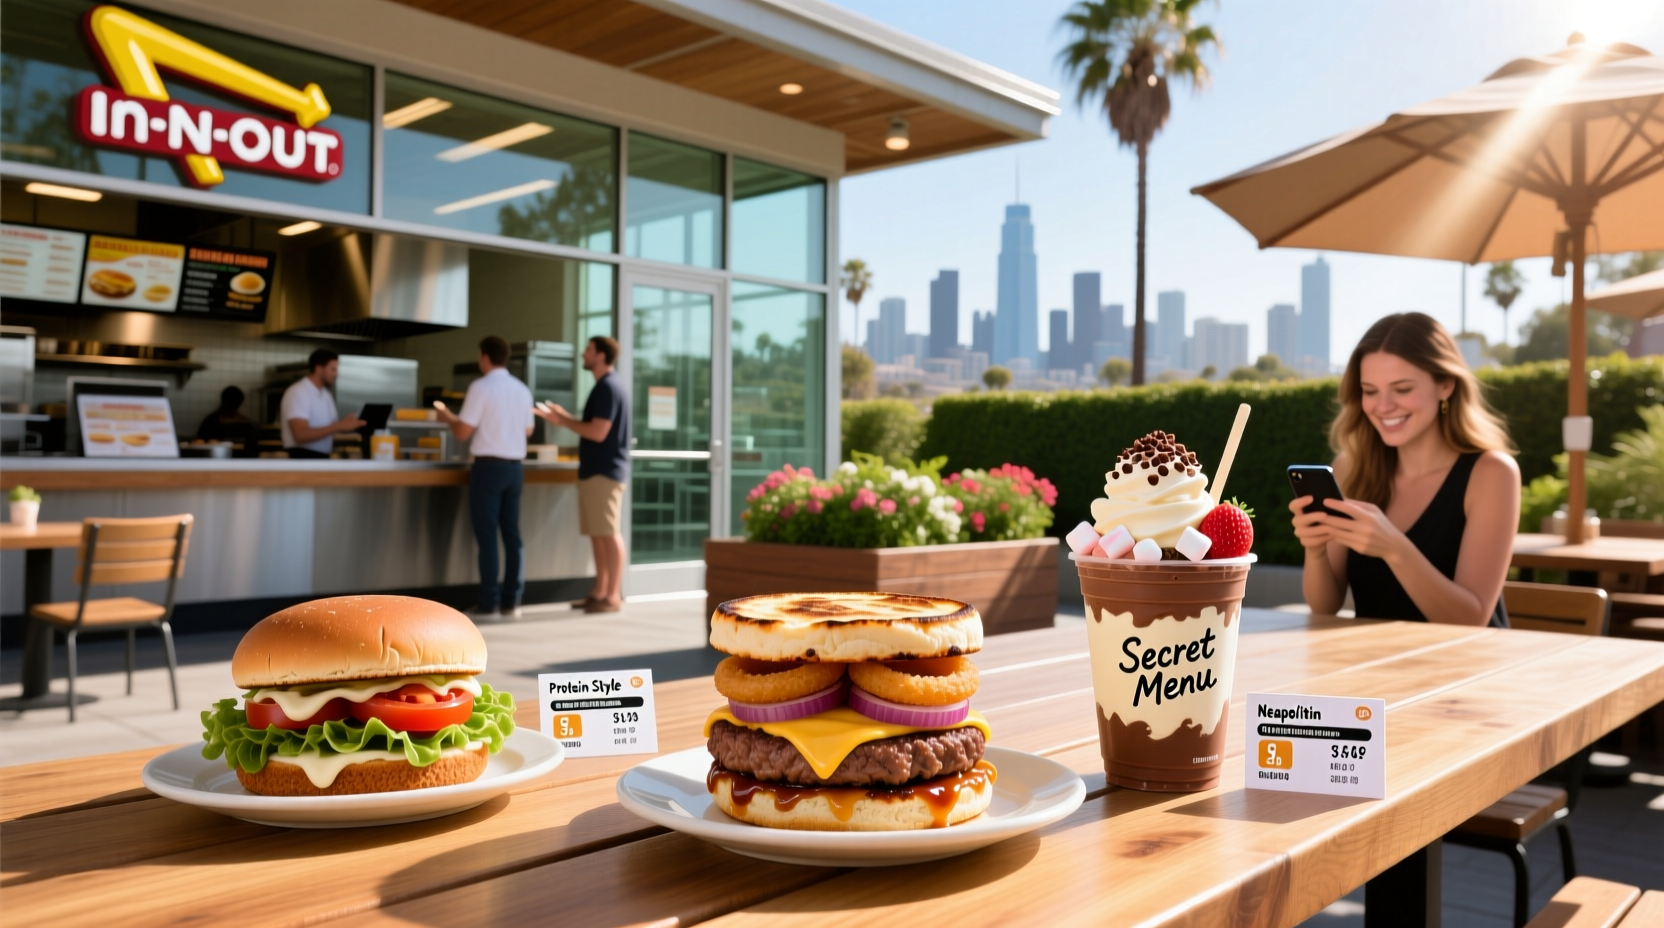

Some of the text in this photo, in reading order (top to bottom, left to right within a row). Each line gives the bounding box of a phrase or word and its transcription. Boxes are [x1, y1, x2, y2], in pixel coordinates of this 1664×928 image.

[90, 90, 339, 174] In-N-OUT
[1118, 627, 1216, 674] Secret
[549, 681, 589, 694] Protein
[592, 678, 622, 695] Style
[1132, 668, 1218, 707] Menu
